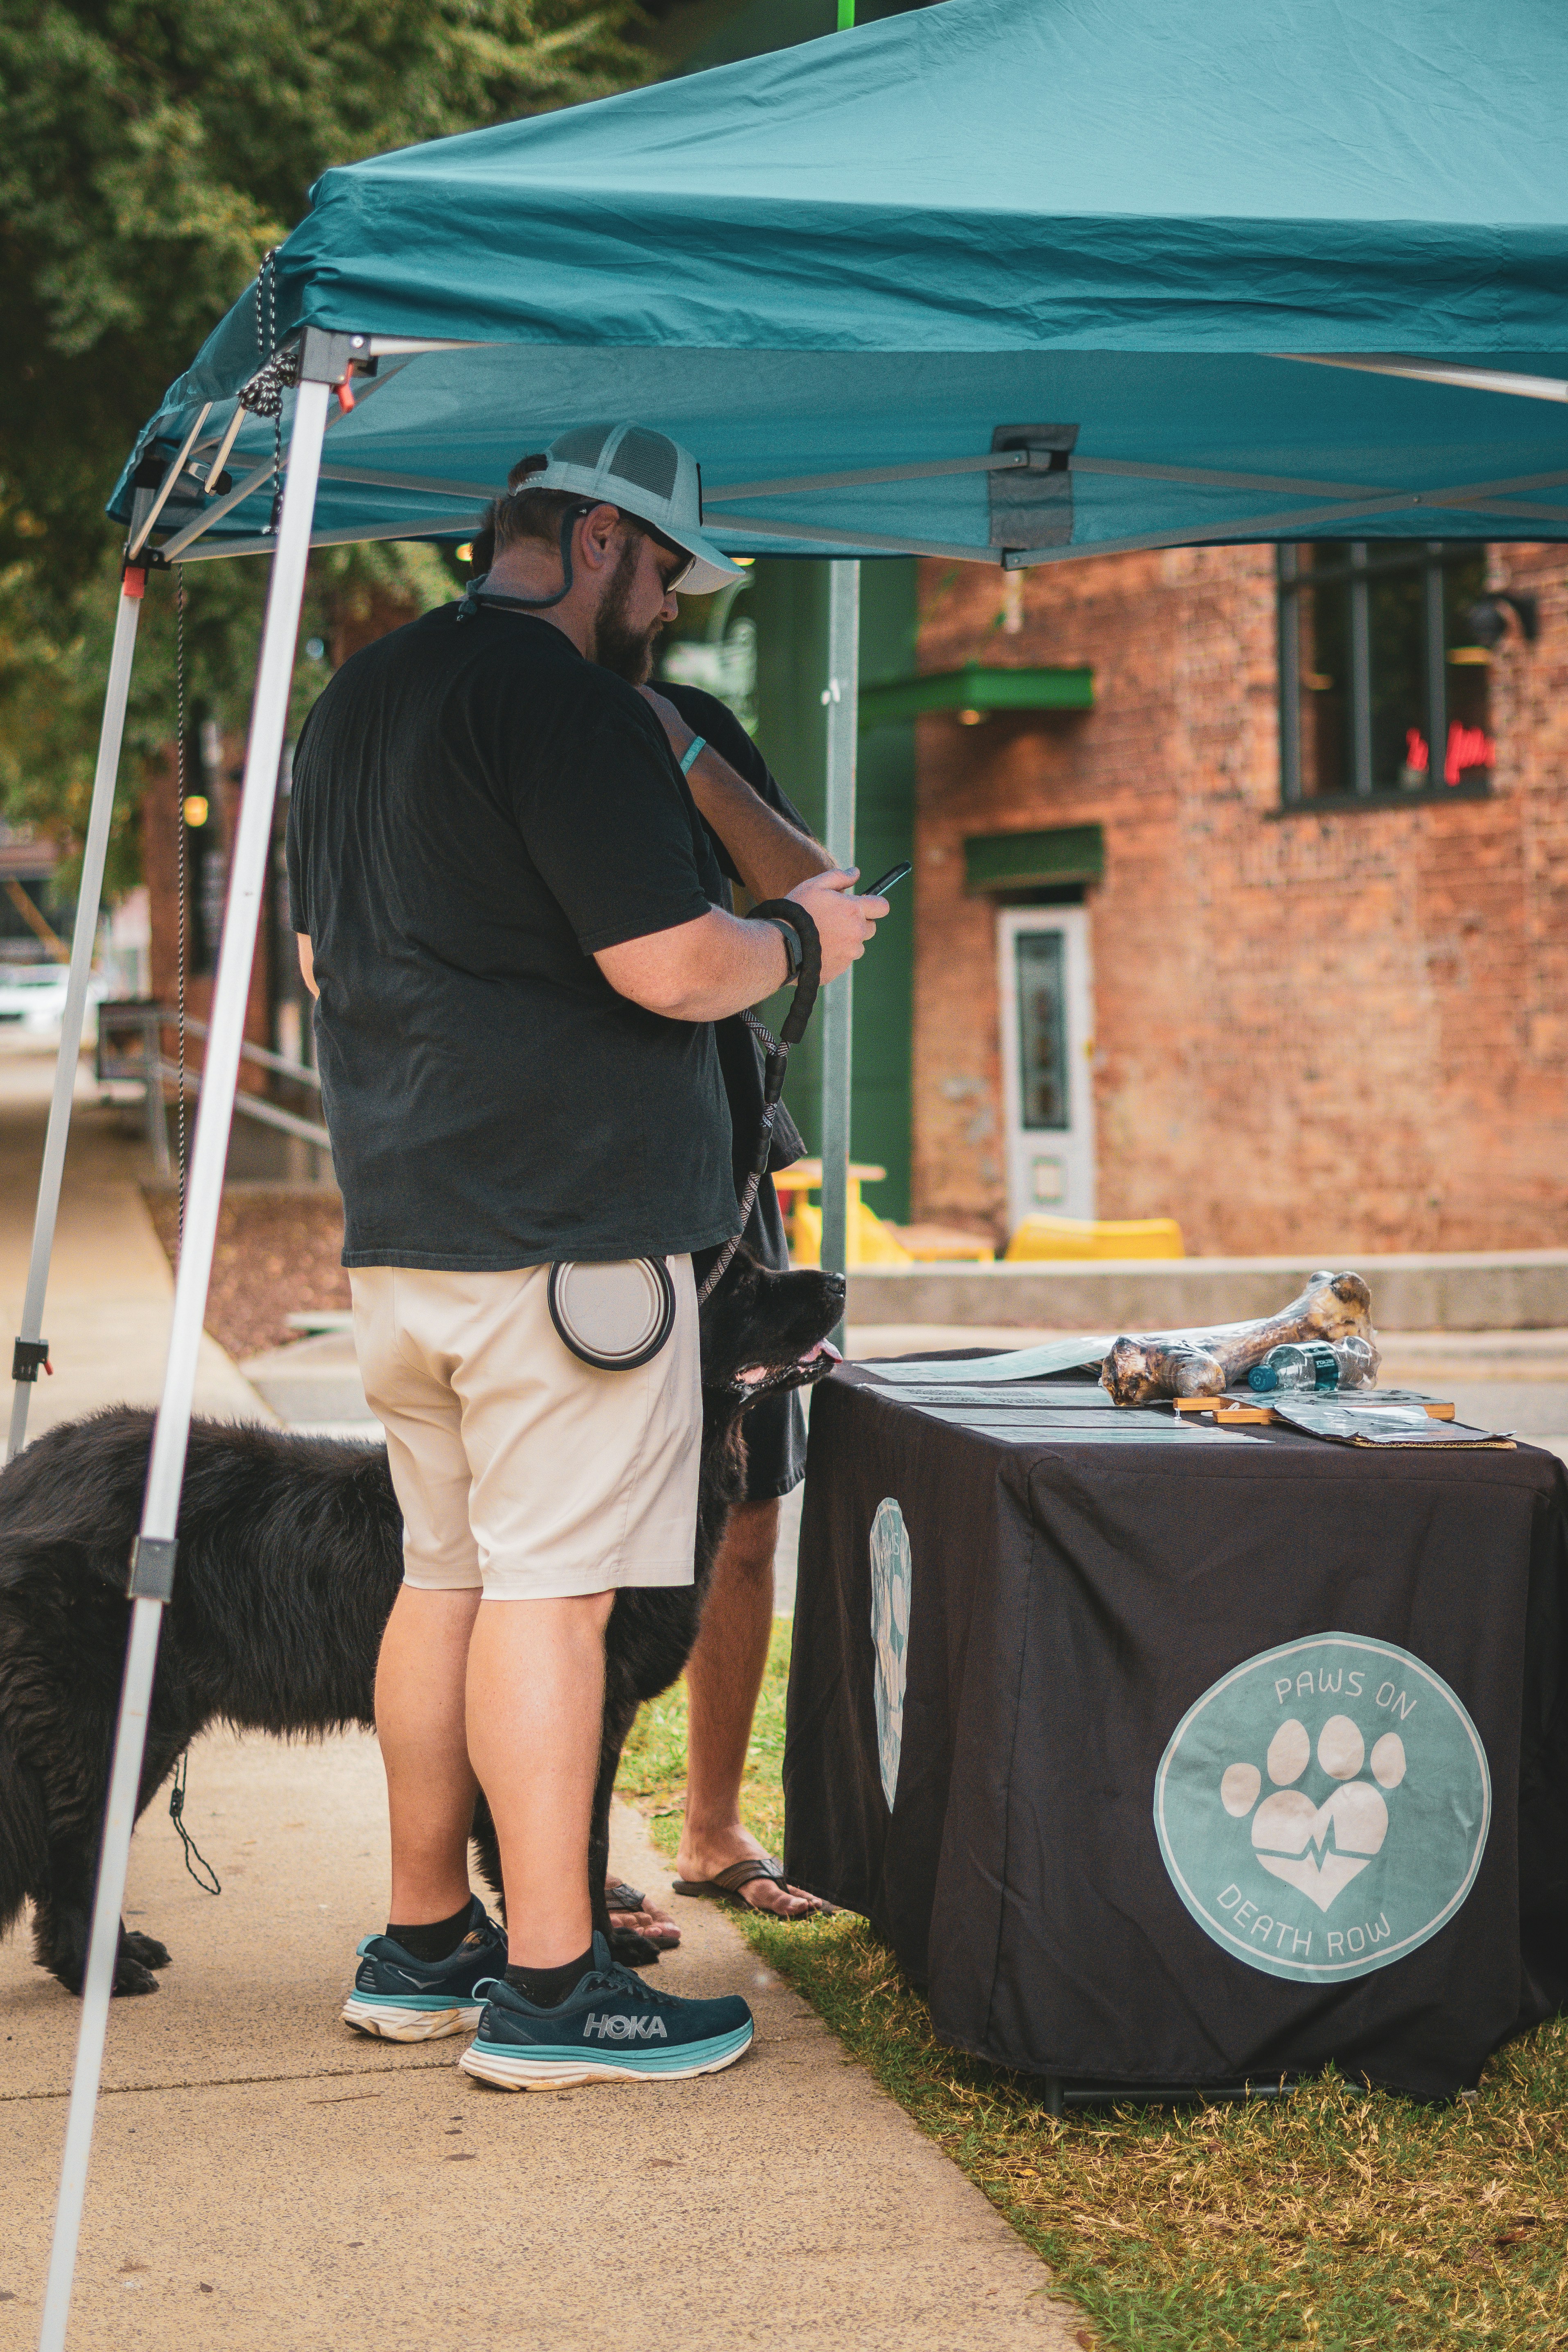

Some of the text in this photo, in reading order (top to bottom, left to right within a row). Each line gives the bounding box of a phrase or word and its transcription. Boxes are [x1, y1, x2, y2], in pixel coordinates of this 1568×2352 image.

[1275, 1668, 1417, 1720] PAWS ON
[1217, 1884, 1391, 1957] DEATH ROW
[584, 2013, 667, 2039] HOKA
